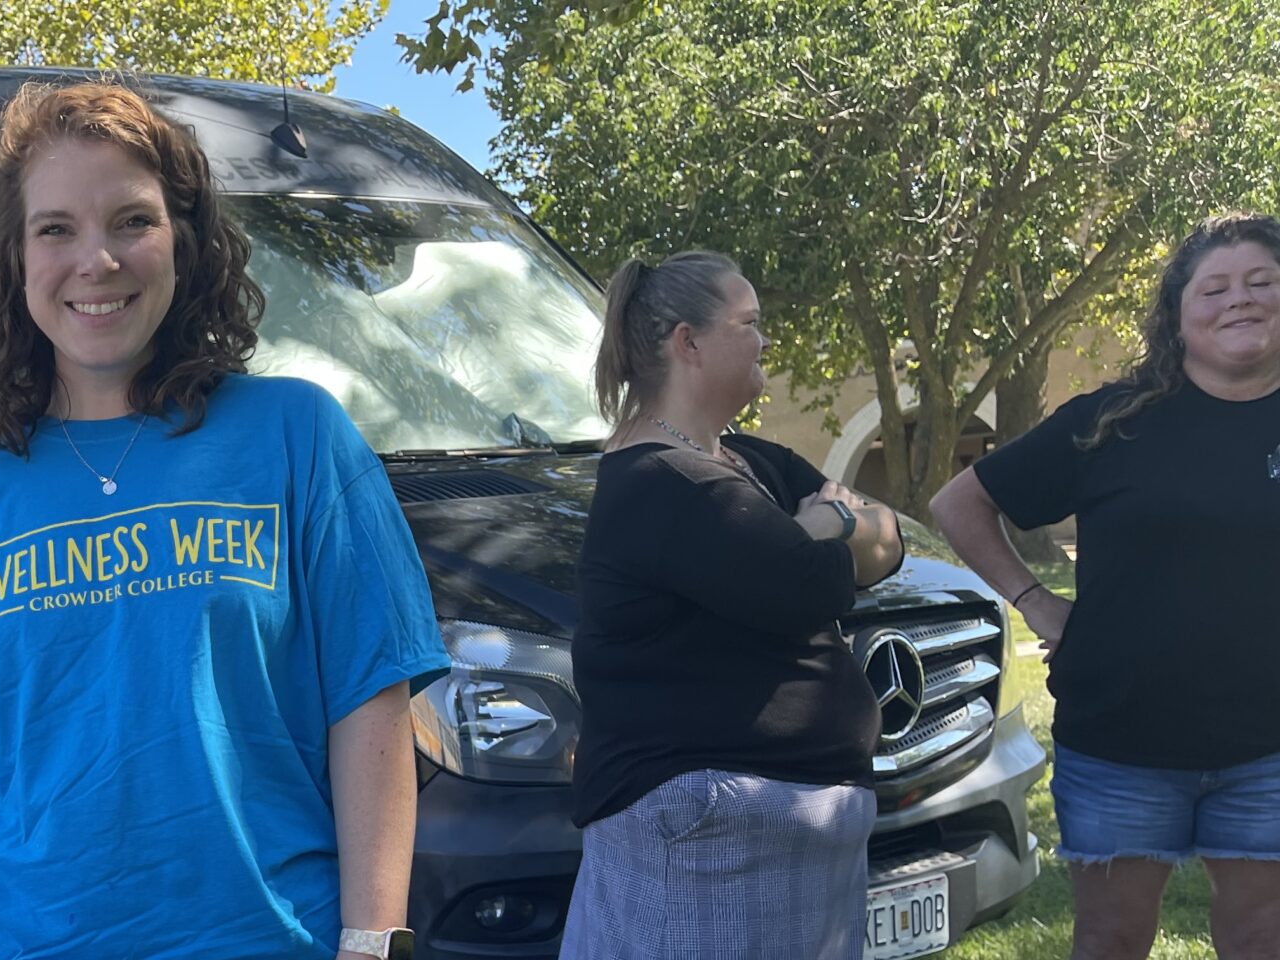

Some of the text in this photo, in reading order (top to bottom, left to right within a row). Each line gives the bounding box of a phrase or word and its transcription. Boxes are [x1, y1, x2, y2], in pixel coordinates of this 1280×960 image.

[170, 517, 266, 571] WEEK
[29, 569, 215, 612] CROWDER COLLEGE
